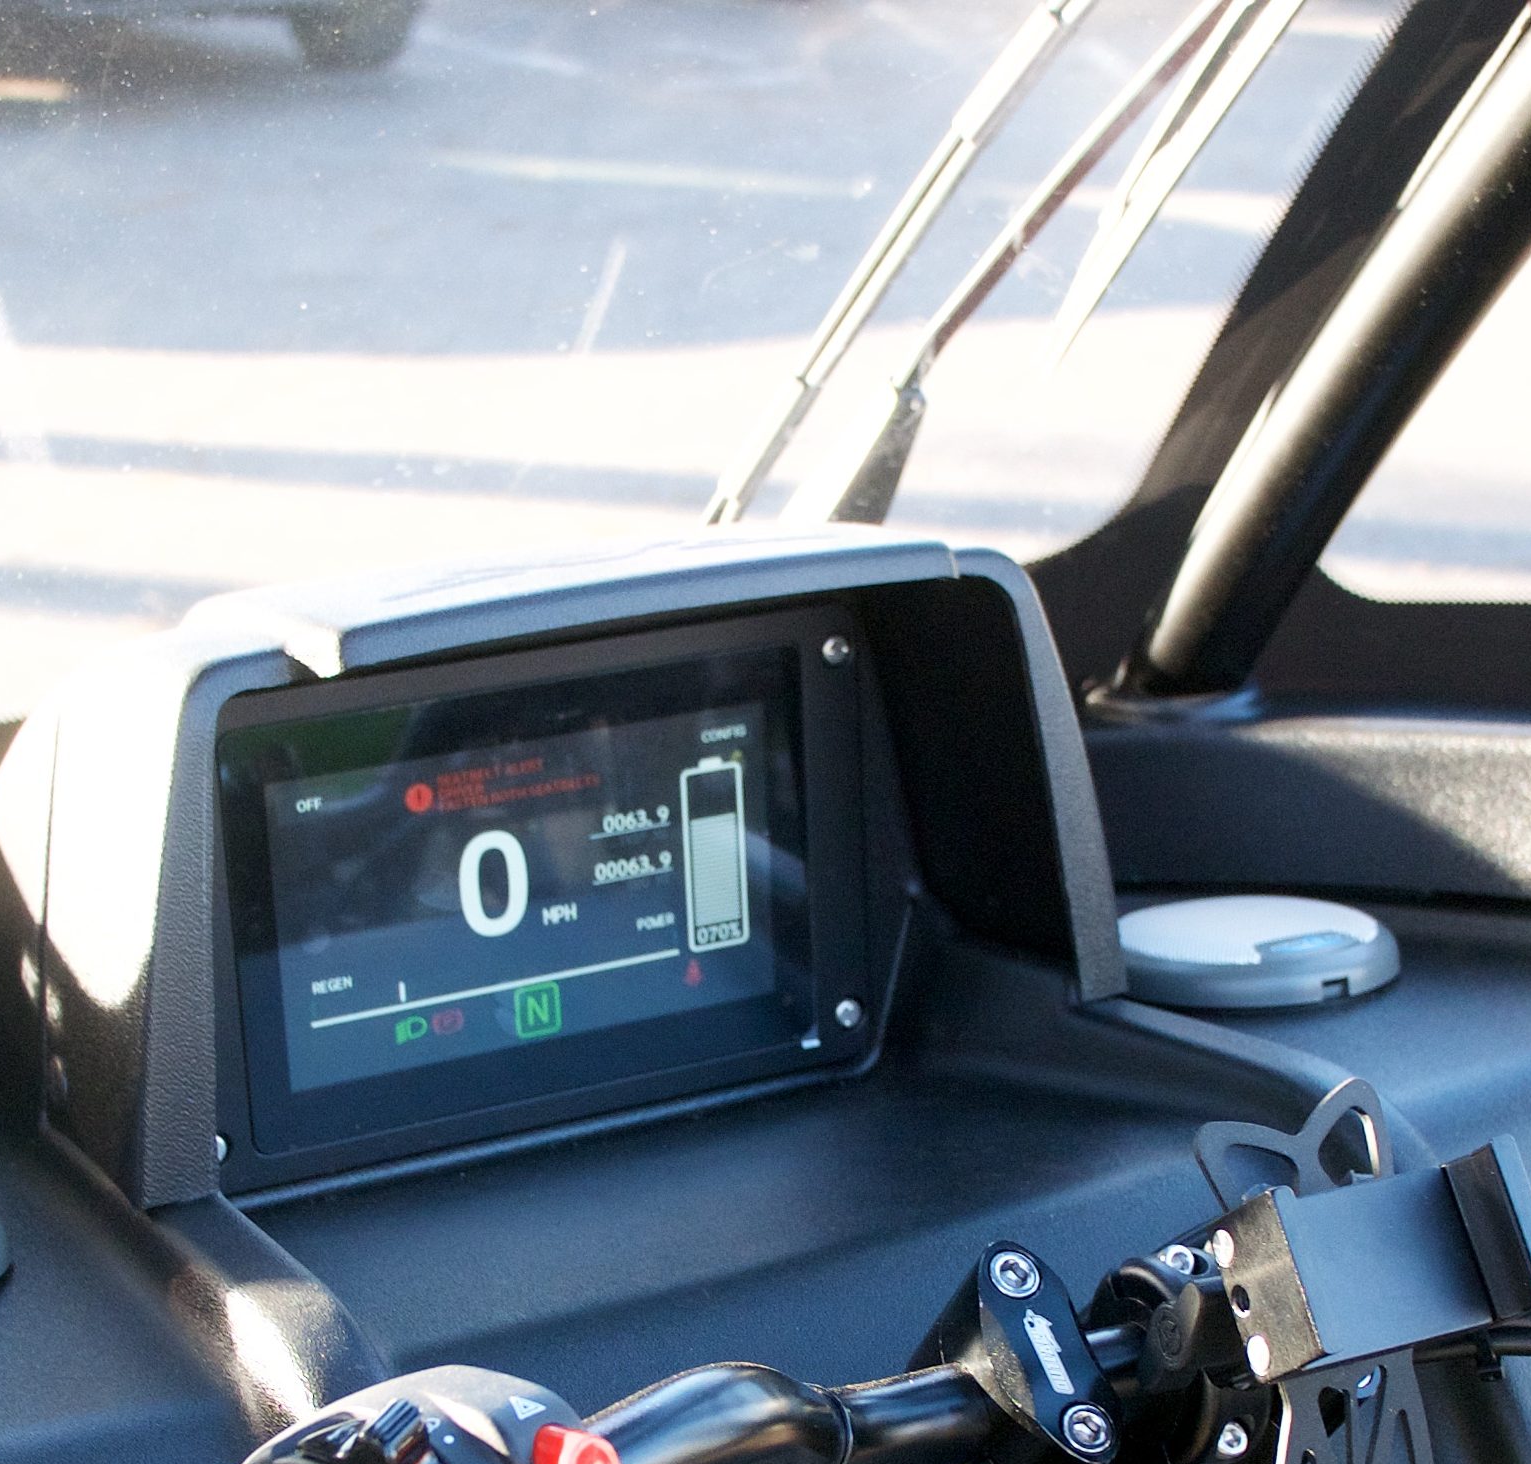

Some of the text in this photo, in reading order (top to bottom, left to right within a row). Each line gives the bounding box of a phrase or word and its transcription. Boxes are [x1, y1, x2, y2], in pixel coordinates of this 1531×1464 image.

[296, 797, 323, 813] OFF
[458, 830, 529, 937] 0
[542, 902, 578, 926] MPH
[636, 911, 675, 931] POWER
[696, 921, 742, 945] 070%
[311, 975, 353, 996] REGEN
[526, 993, 551, 1026] N
